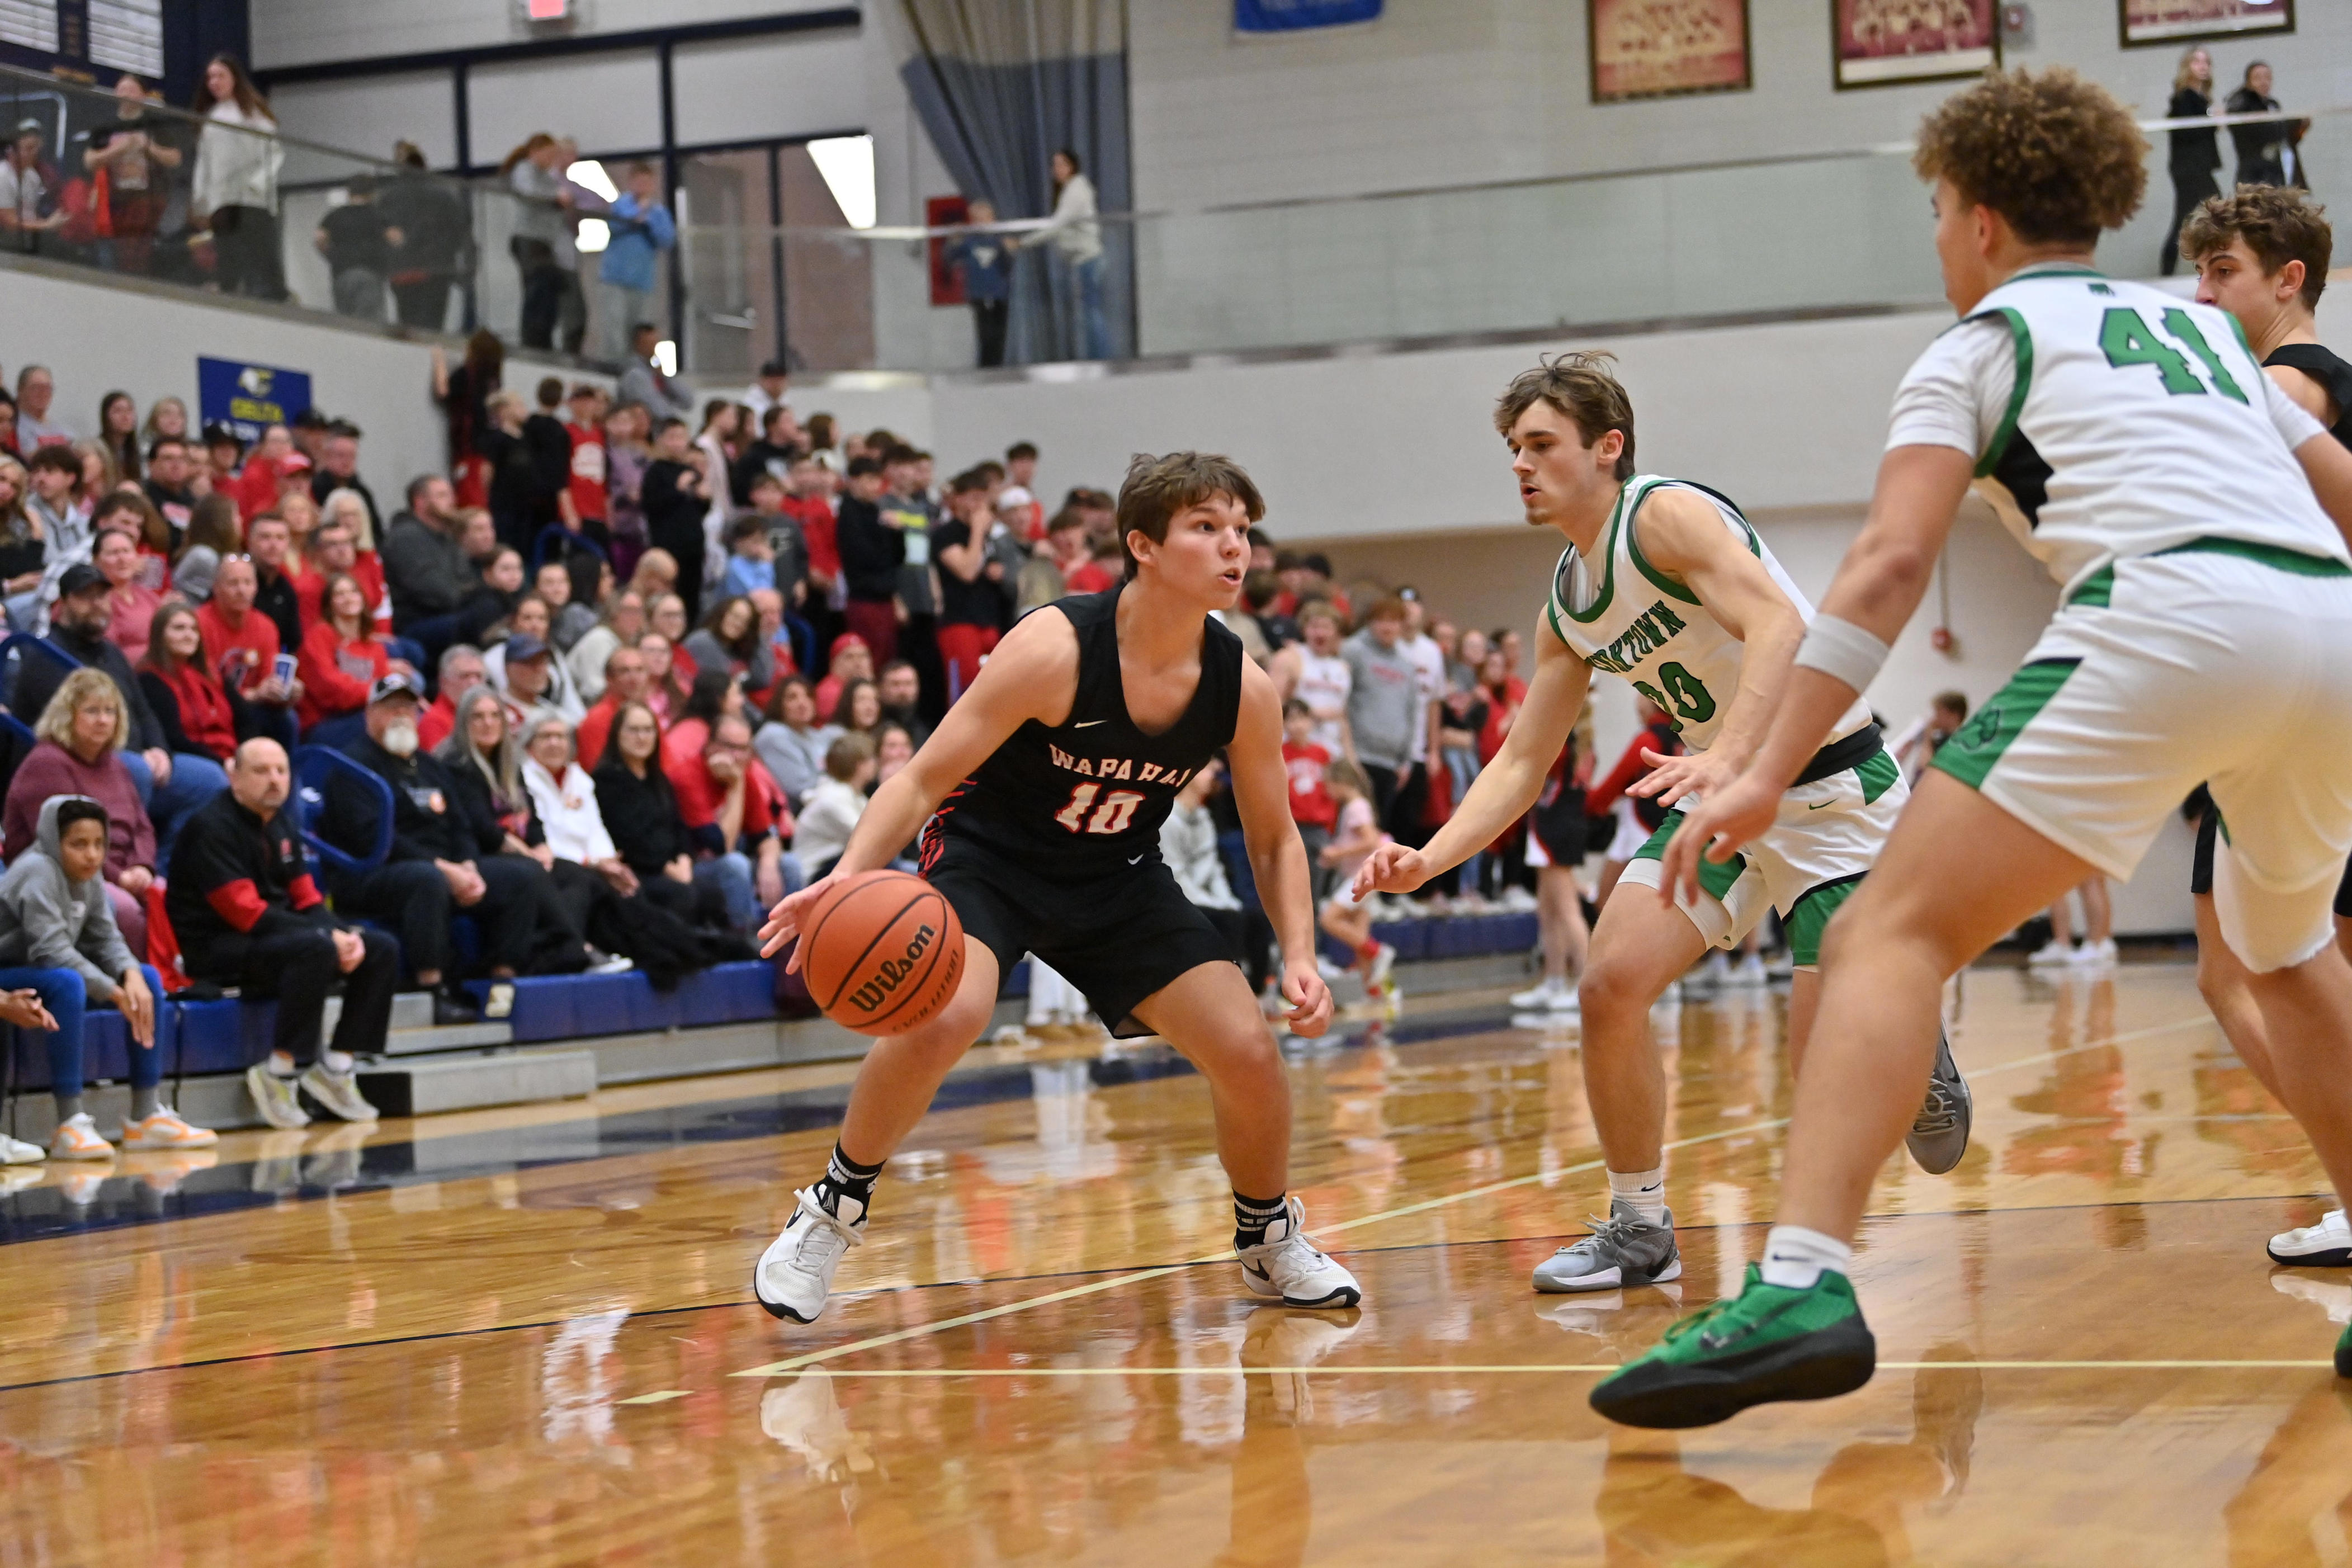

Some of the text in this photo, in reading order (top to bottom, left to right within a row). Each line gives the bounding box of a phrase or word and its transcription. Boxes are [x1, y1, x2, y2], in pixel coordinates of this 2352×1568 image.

[2098, 307, 2249, 405] 41
[1054, 781, 1146, 834] 10
[848, 924, 936, 1013] Wilson
